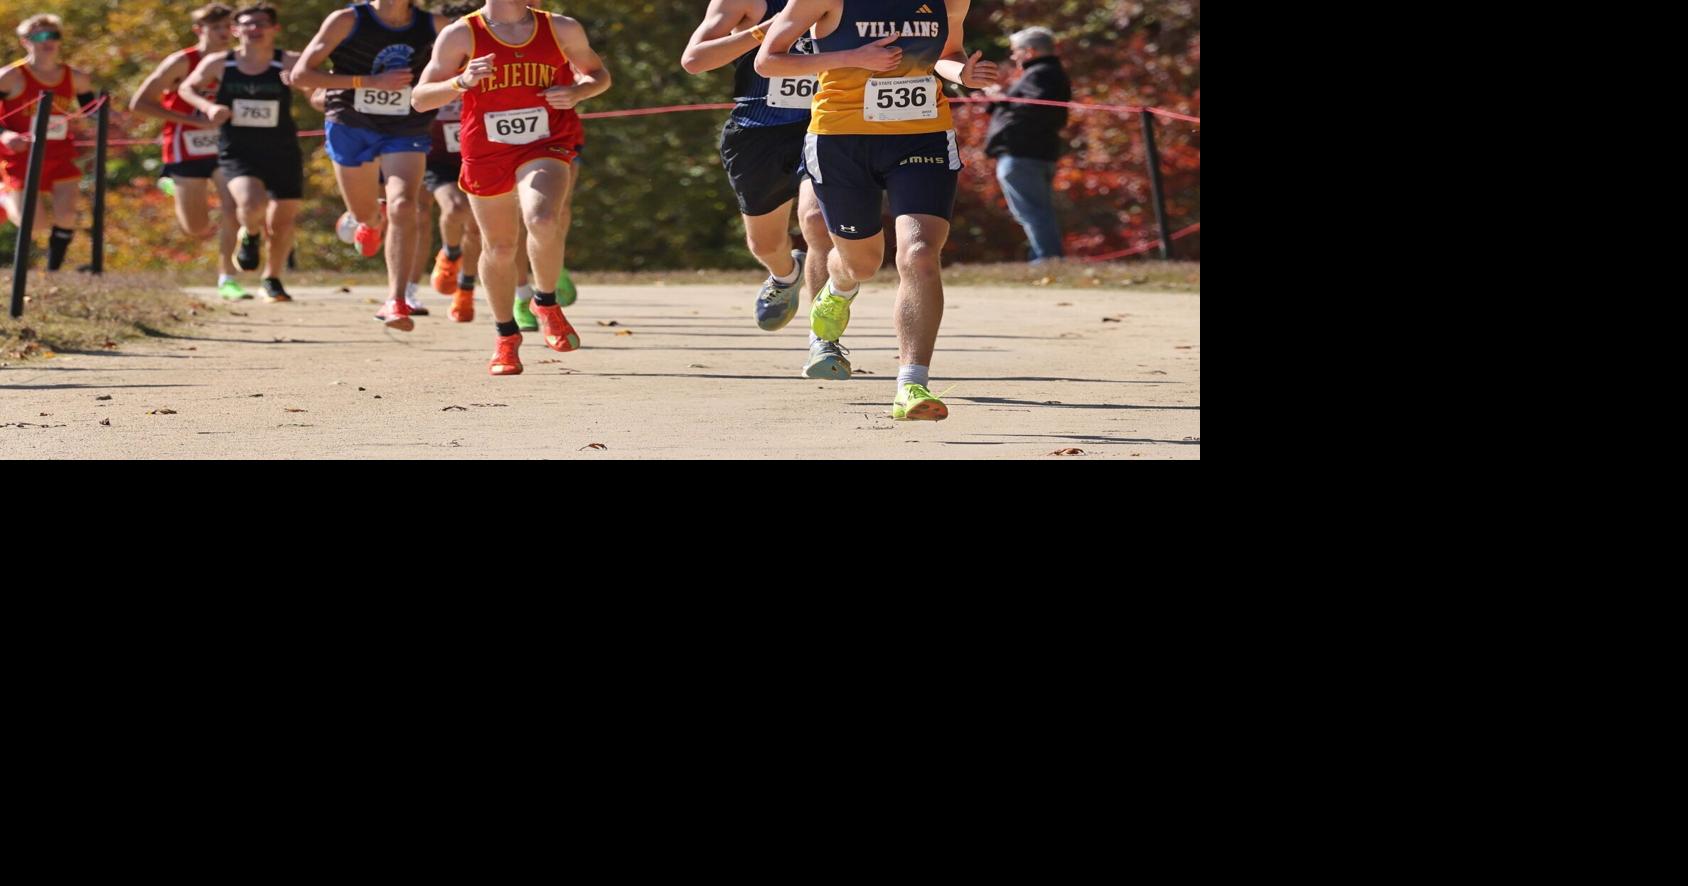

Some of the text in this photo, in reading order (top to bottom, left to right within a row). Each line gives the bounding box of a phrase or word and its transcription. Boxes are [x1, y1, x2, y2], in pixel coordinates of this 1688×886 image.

[855, 21, 939, 38] VILLAINS
[363, 90, 402, 106] 592
[876, 86, 926, 109] 536
[241, 106, 271, 119] 763
[496, 116, 539, 136] 697
